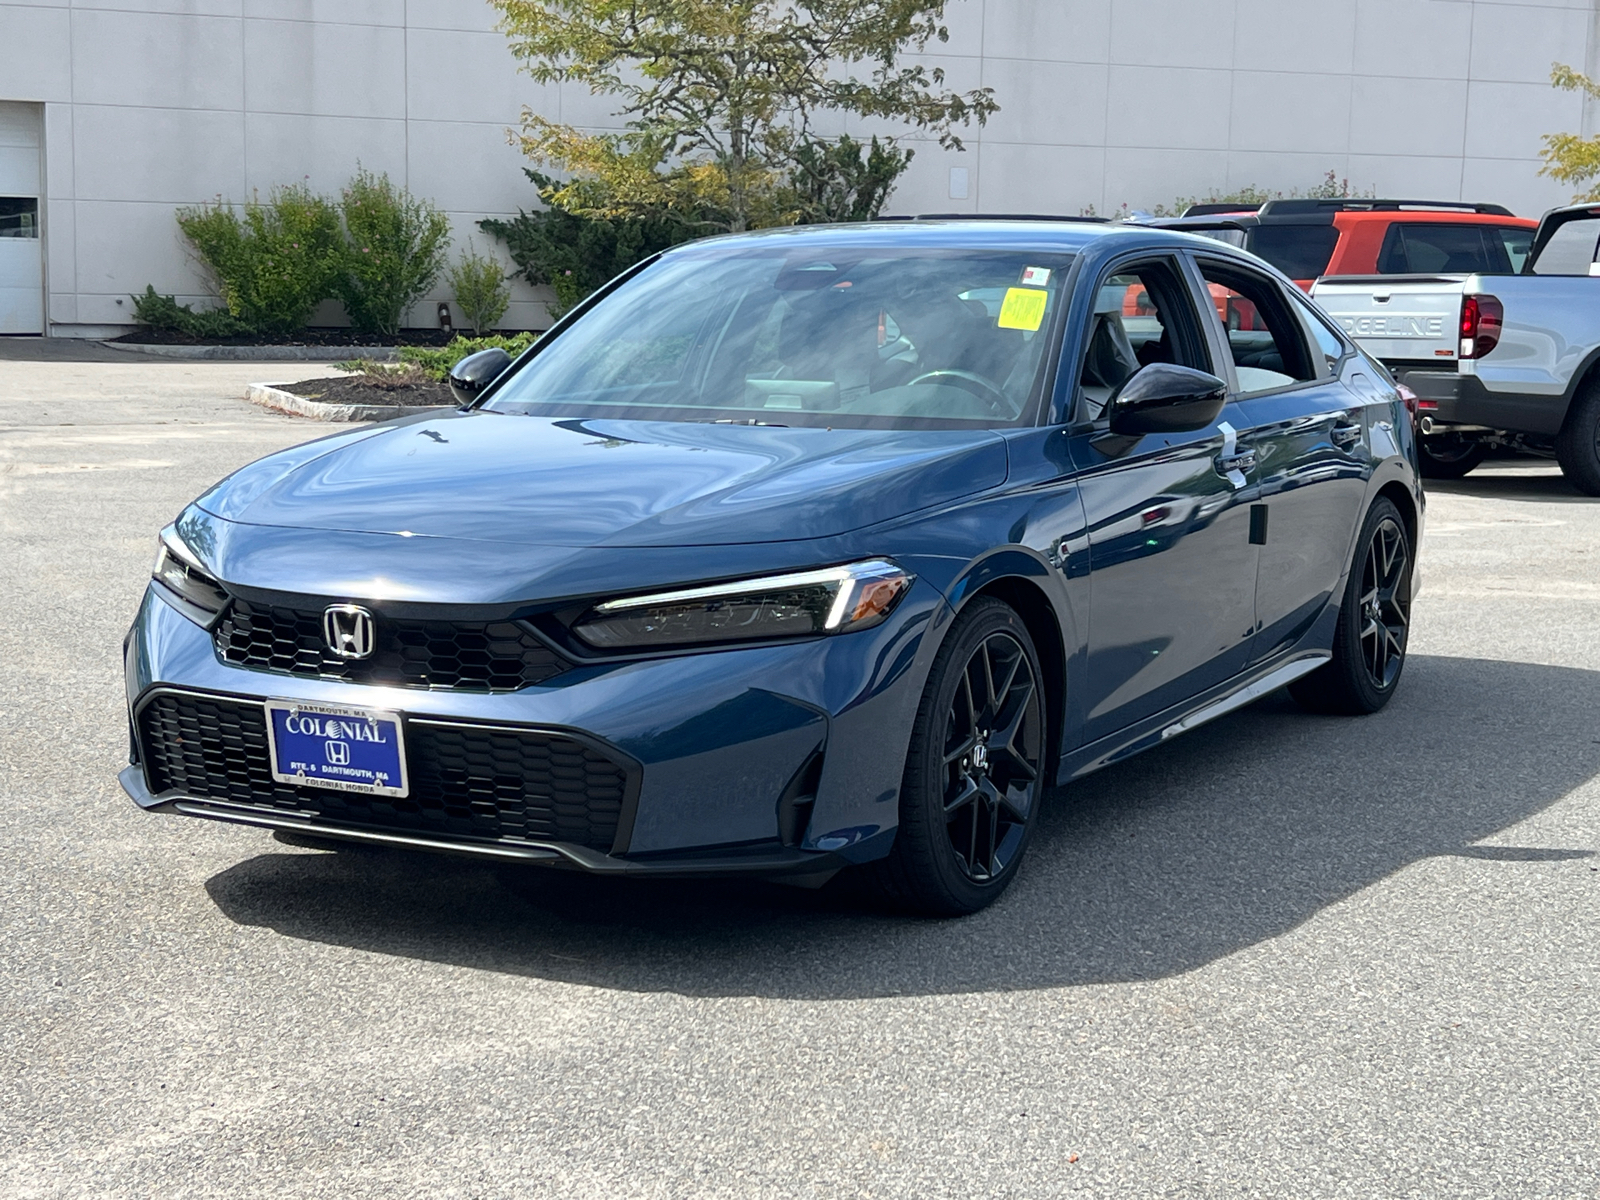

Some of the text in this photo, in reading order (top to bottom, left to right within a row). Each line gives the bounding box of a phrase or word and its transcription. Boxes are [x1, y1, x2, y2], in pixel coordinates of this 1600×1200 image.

[1337, 316, 1443, 336] DGELINE
[285, 715, 387, 744] COLONIAL
[322, 765, 375, 779] DARTMOUTH,
[375, 771, 389, 781] MA
[305, 778, 375, 793] COLONIAL HONDA
